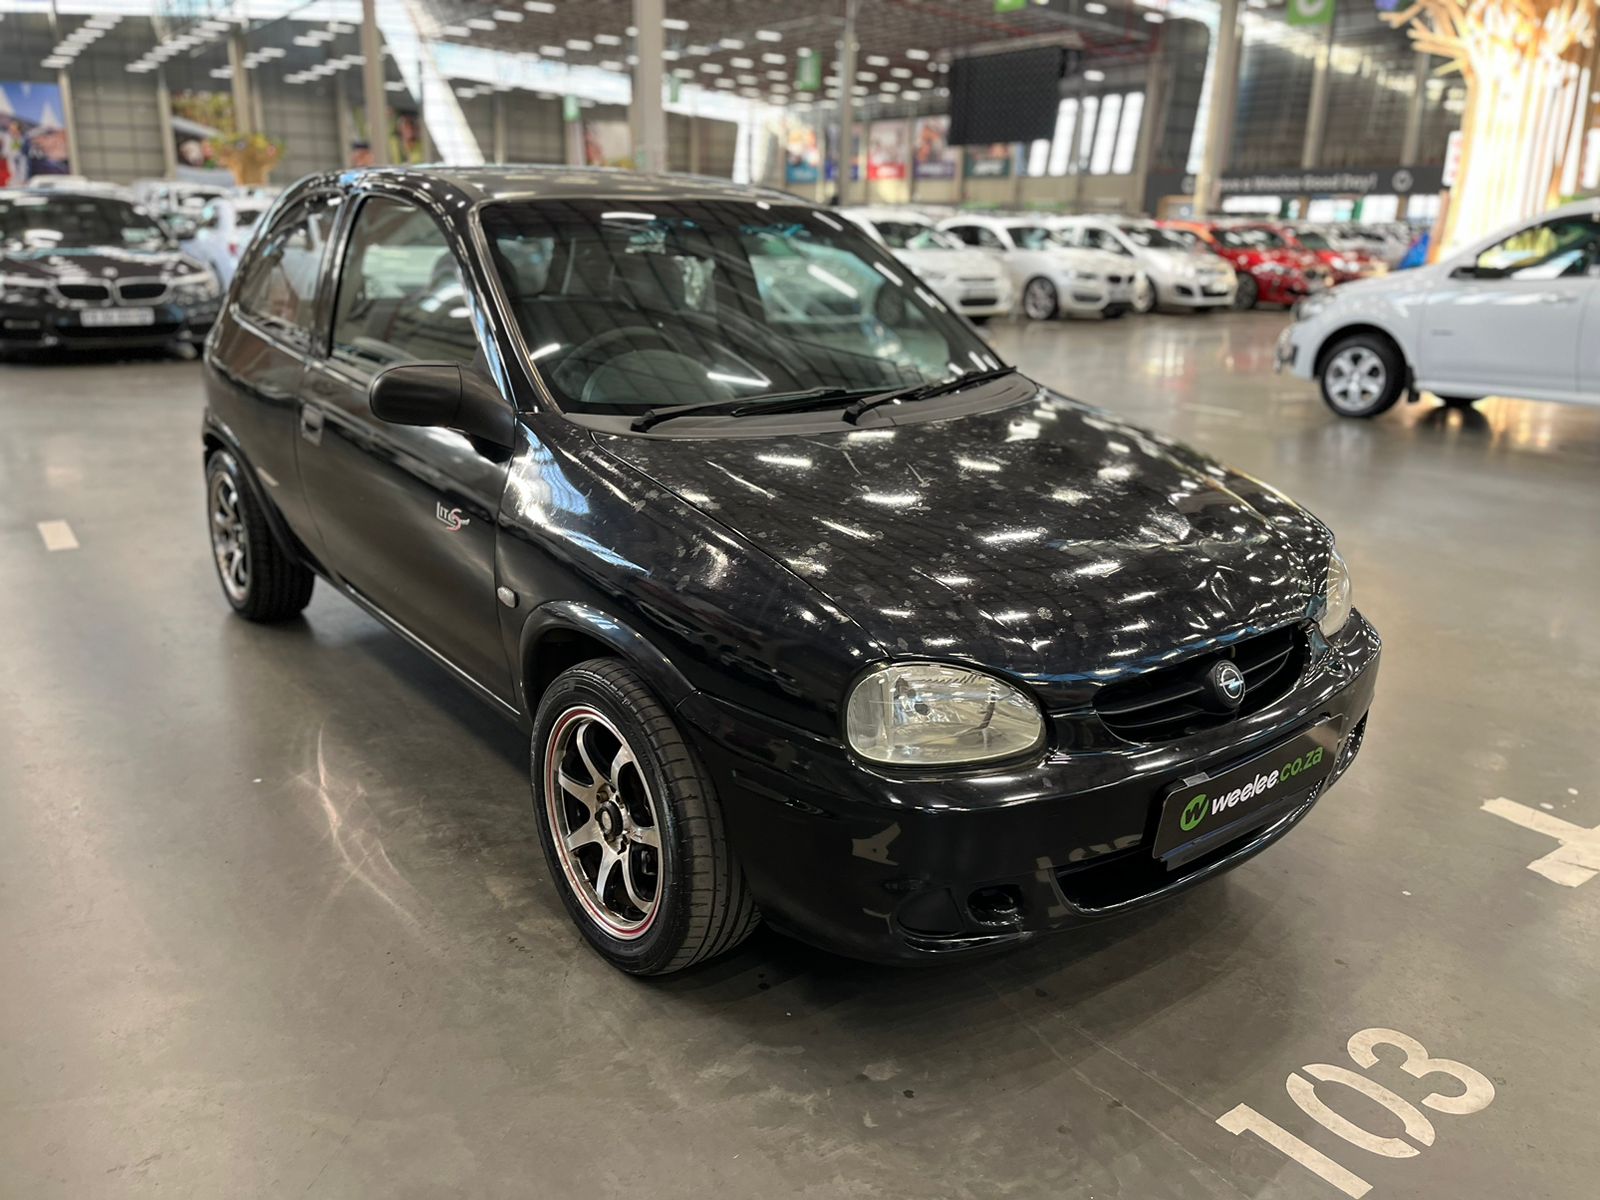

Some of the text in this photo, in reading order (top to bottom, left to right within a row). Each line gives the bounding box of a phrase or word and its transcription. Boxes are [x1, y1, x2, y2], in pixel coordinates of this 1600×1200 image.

[1217, 177, 1240, 192] ave
[1303, 174, 1339, 191] Good
[1341, 172, 1377, 193] Day!
[1211, 746, 1324, 815] weelee.co.za
[1215, 1027, 1496, 1199] 103
